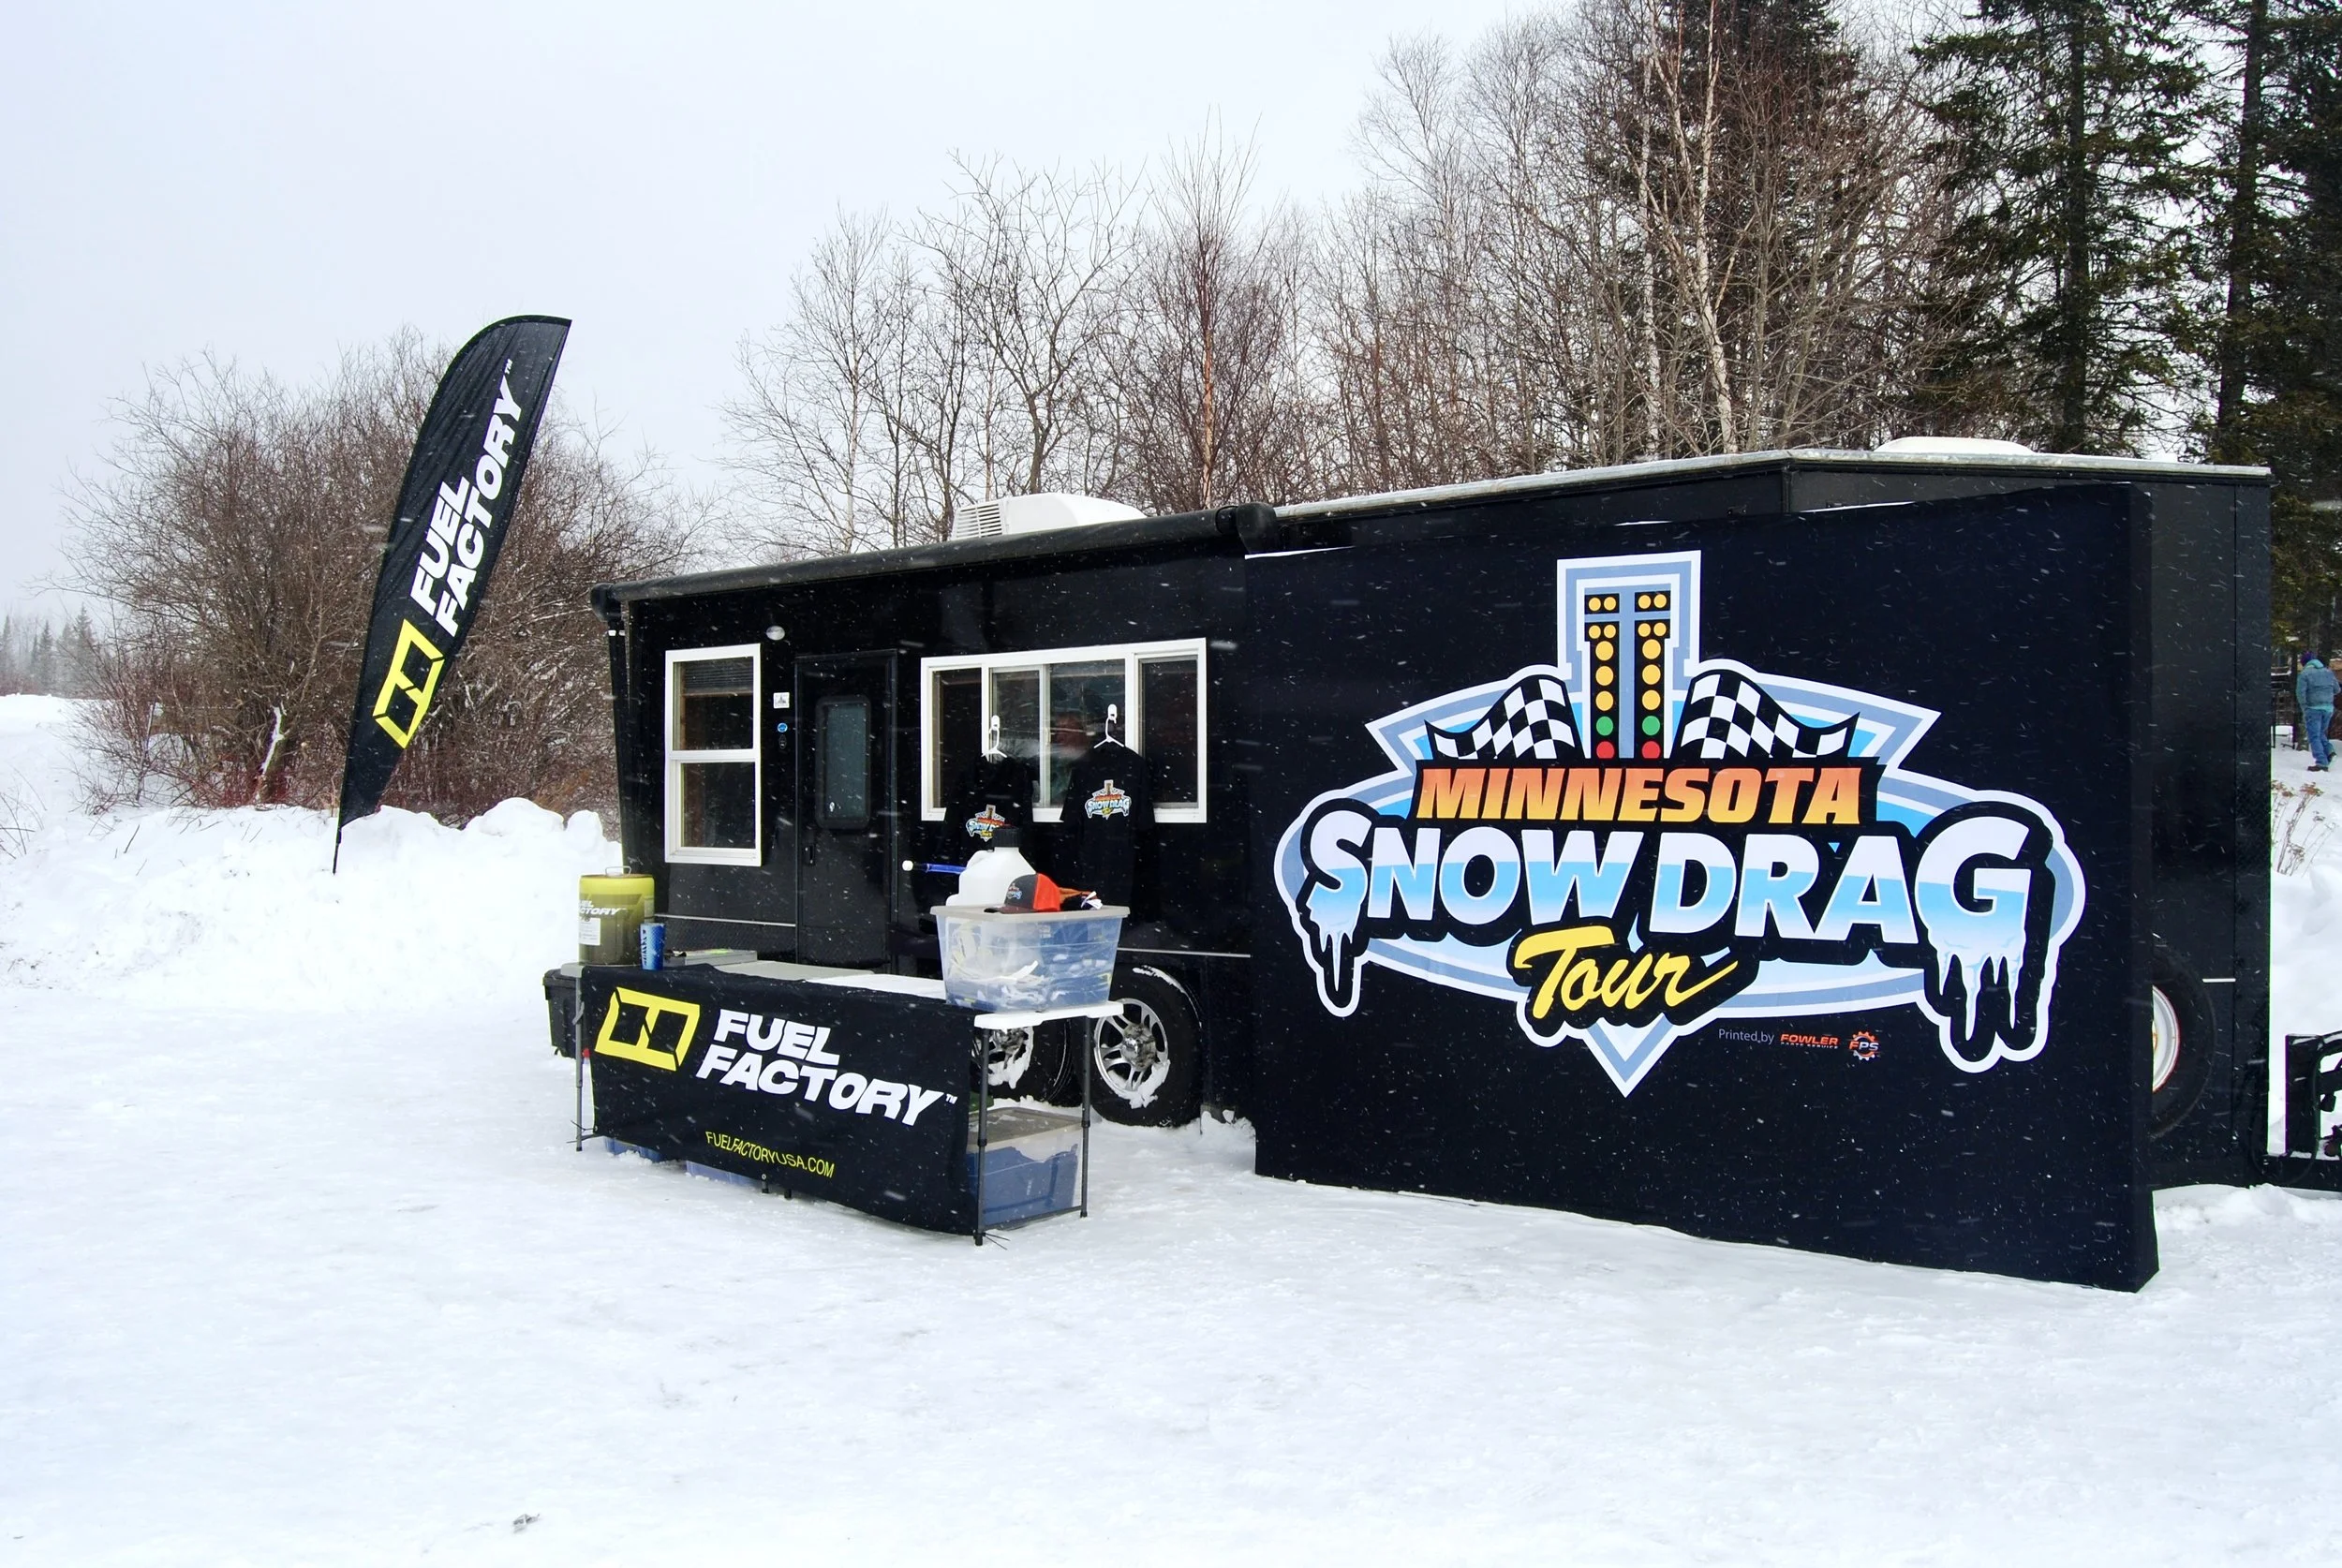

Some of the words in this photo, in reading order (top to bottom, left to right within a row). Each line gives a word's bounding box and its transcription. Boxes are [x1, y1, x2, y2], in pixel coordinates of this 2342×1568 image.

[435, 376, 522, 637] FACTORY
[409, 476, 469, 616] FUEL
[1416, 766, 1860, 824] MINNESOTA
[1308, 808, 1645, 941] SNOW
[1649, 815, 2033, 960] DRAG
[1514, 925, 1740, 1020] Tour
[713, 1009, 840, 1066] FUEL
[1718, 1028, 1757, 1043] Printed
[1760, 1031, 1774, 1045] by
[1780, 1033, 1839, 1045] FOWLER
[1848, 1041, 1879, 1052] FPS
[695, 1044, 944, 1126] FACTORY
[704, 1131, 836, 1179] FUELFACTORYUSA.COM
